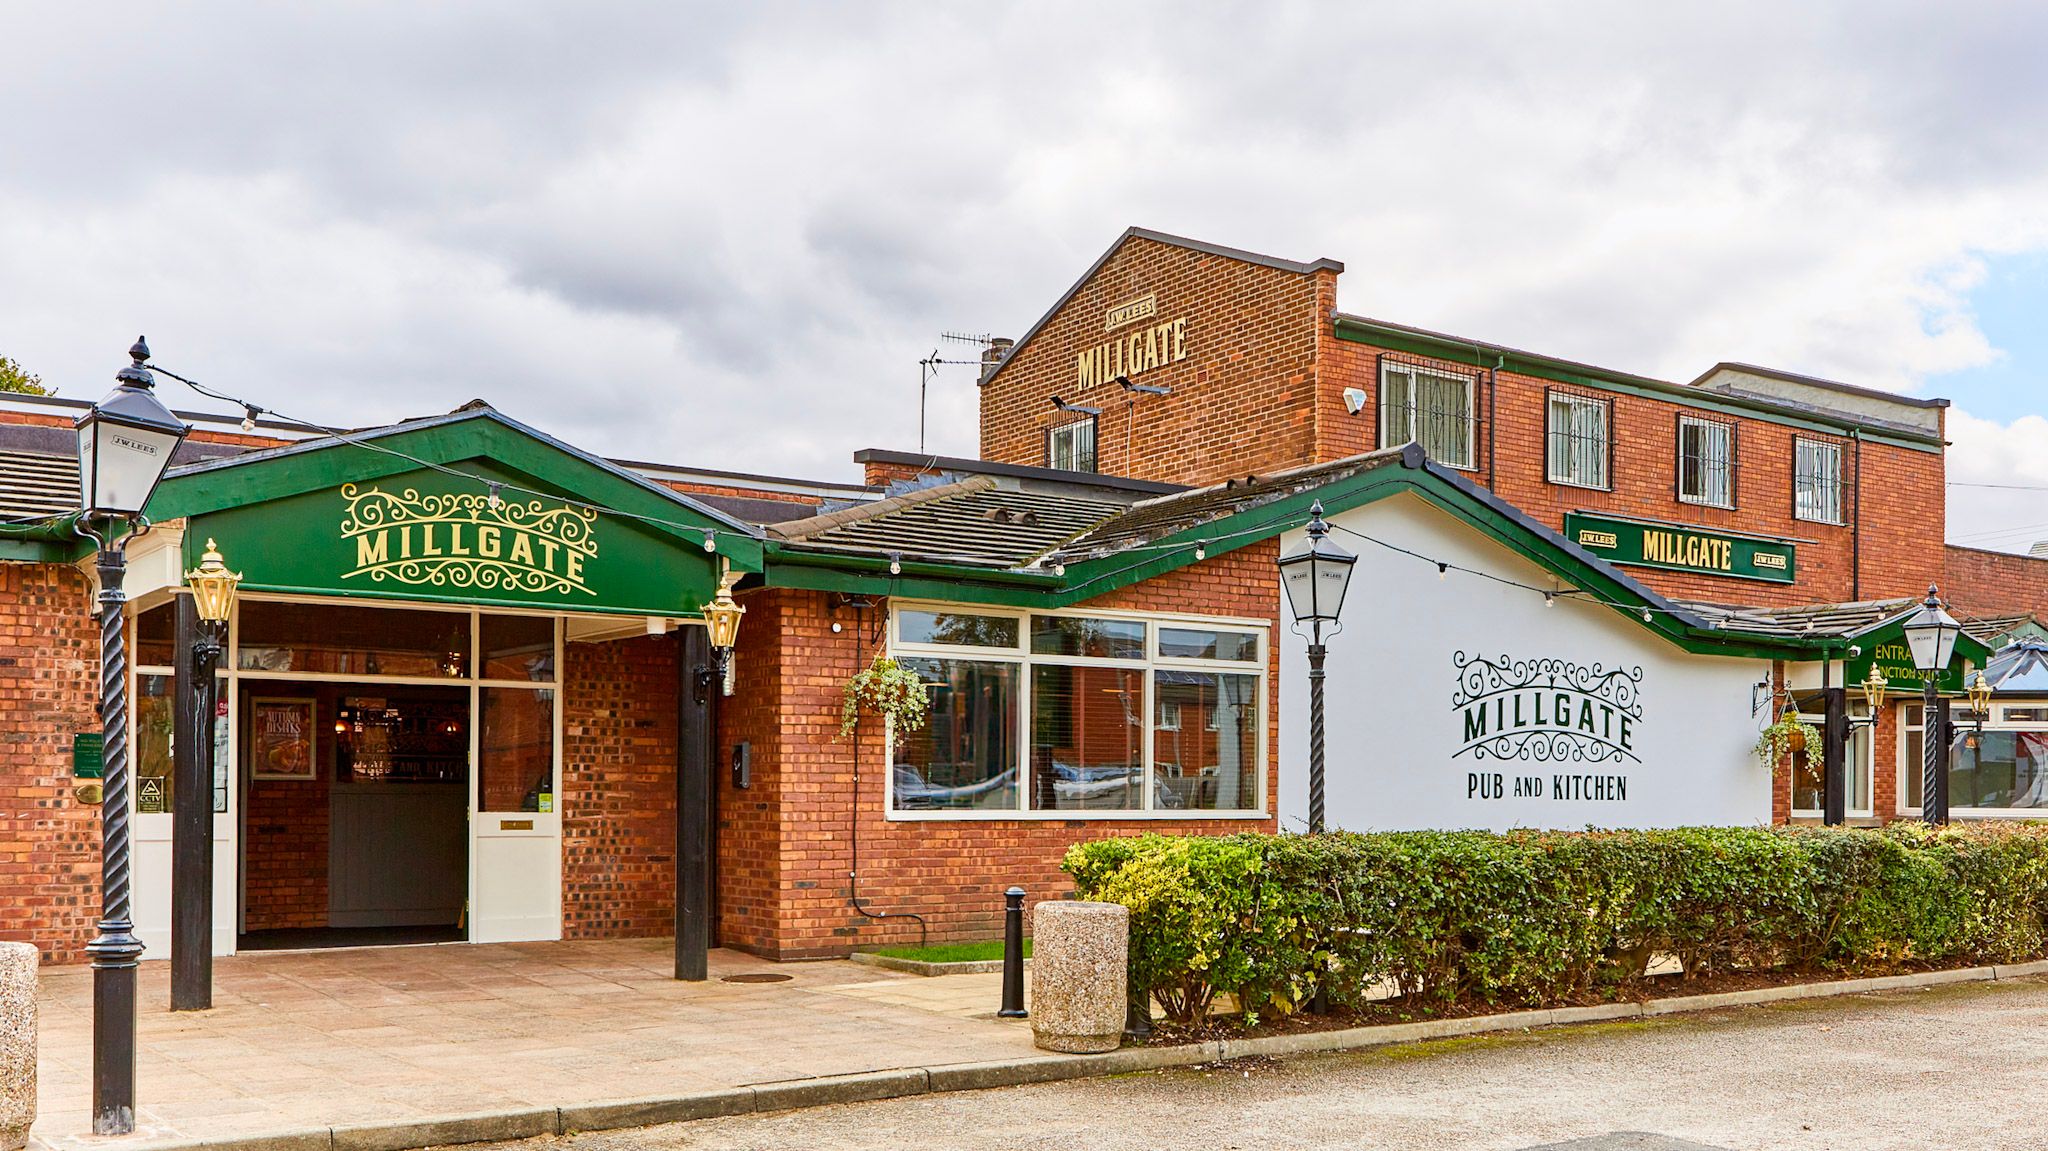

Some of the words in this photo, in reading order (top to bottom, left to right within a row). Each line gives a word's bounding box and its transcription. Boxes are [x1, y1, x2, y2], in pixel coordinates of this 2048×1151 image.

[1078, 317, 1187, 391] MILLGATE
[356, 524, 585, 584] MILLGATE
[1643, 530, 1732, 570] MILLGATE
[1875, 644, 1913, 662] ENTRA
[1878, 665, 1916, 680] NCTION
[1464, 692, 1633, 750] MILLGATE
[1468, 773, 1504, 800] PUB
[1514, 777, 1543, 798] AND
[1553, 775, 1627, 800] KITCHEN
